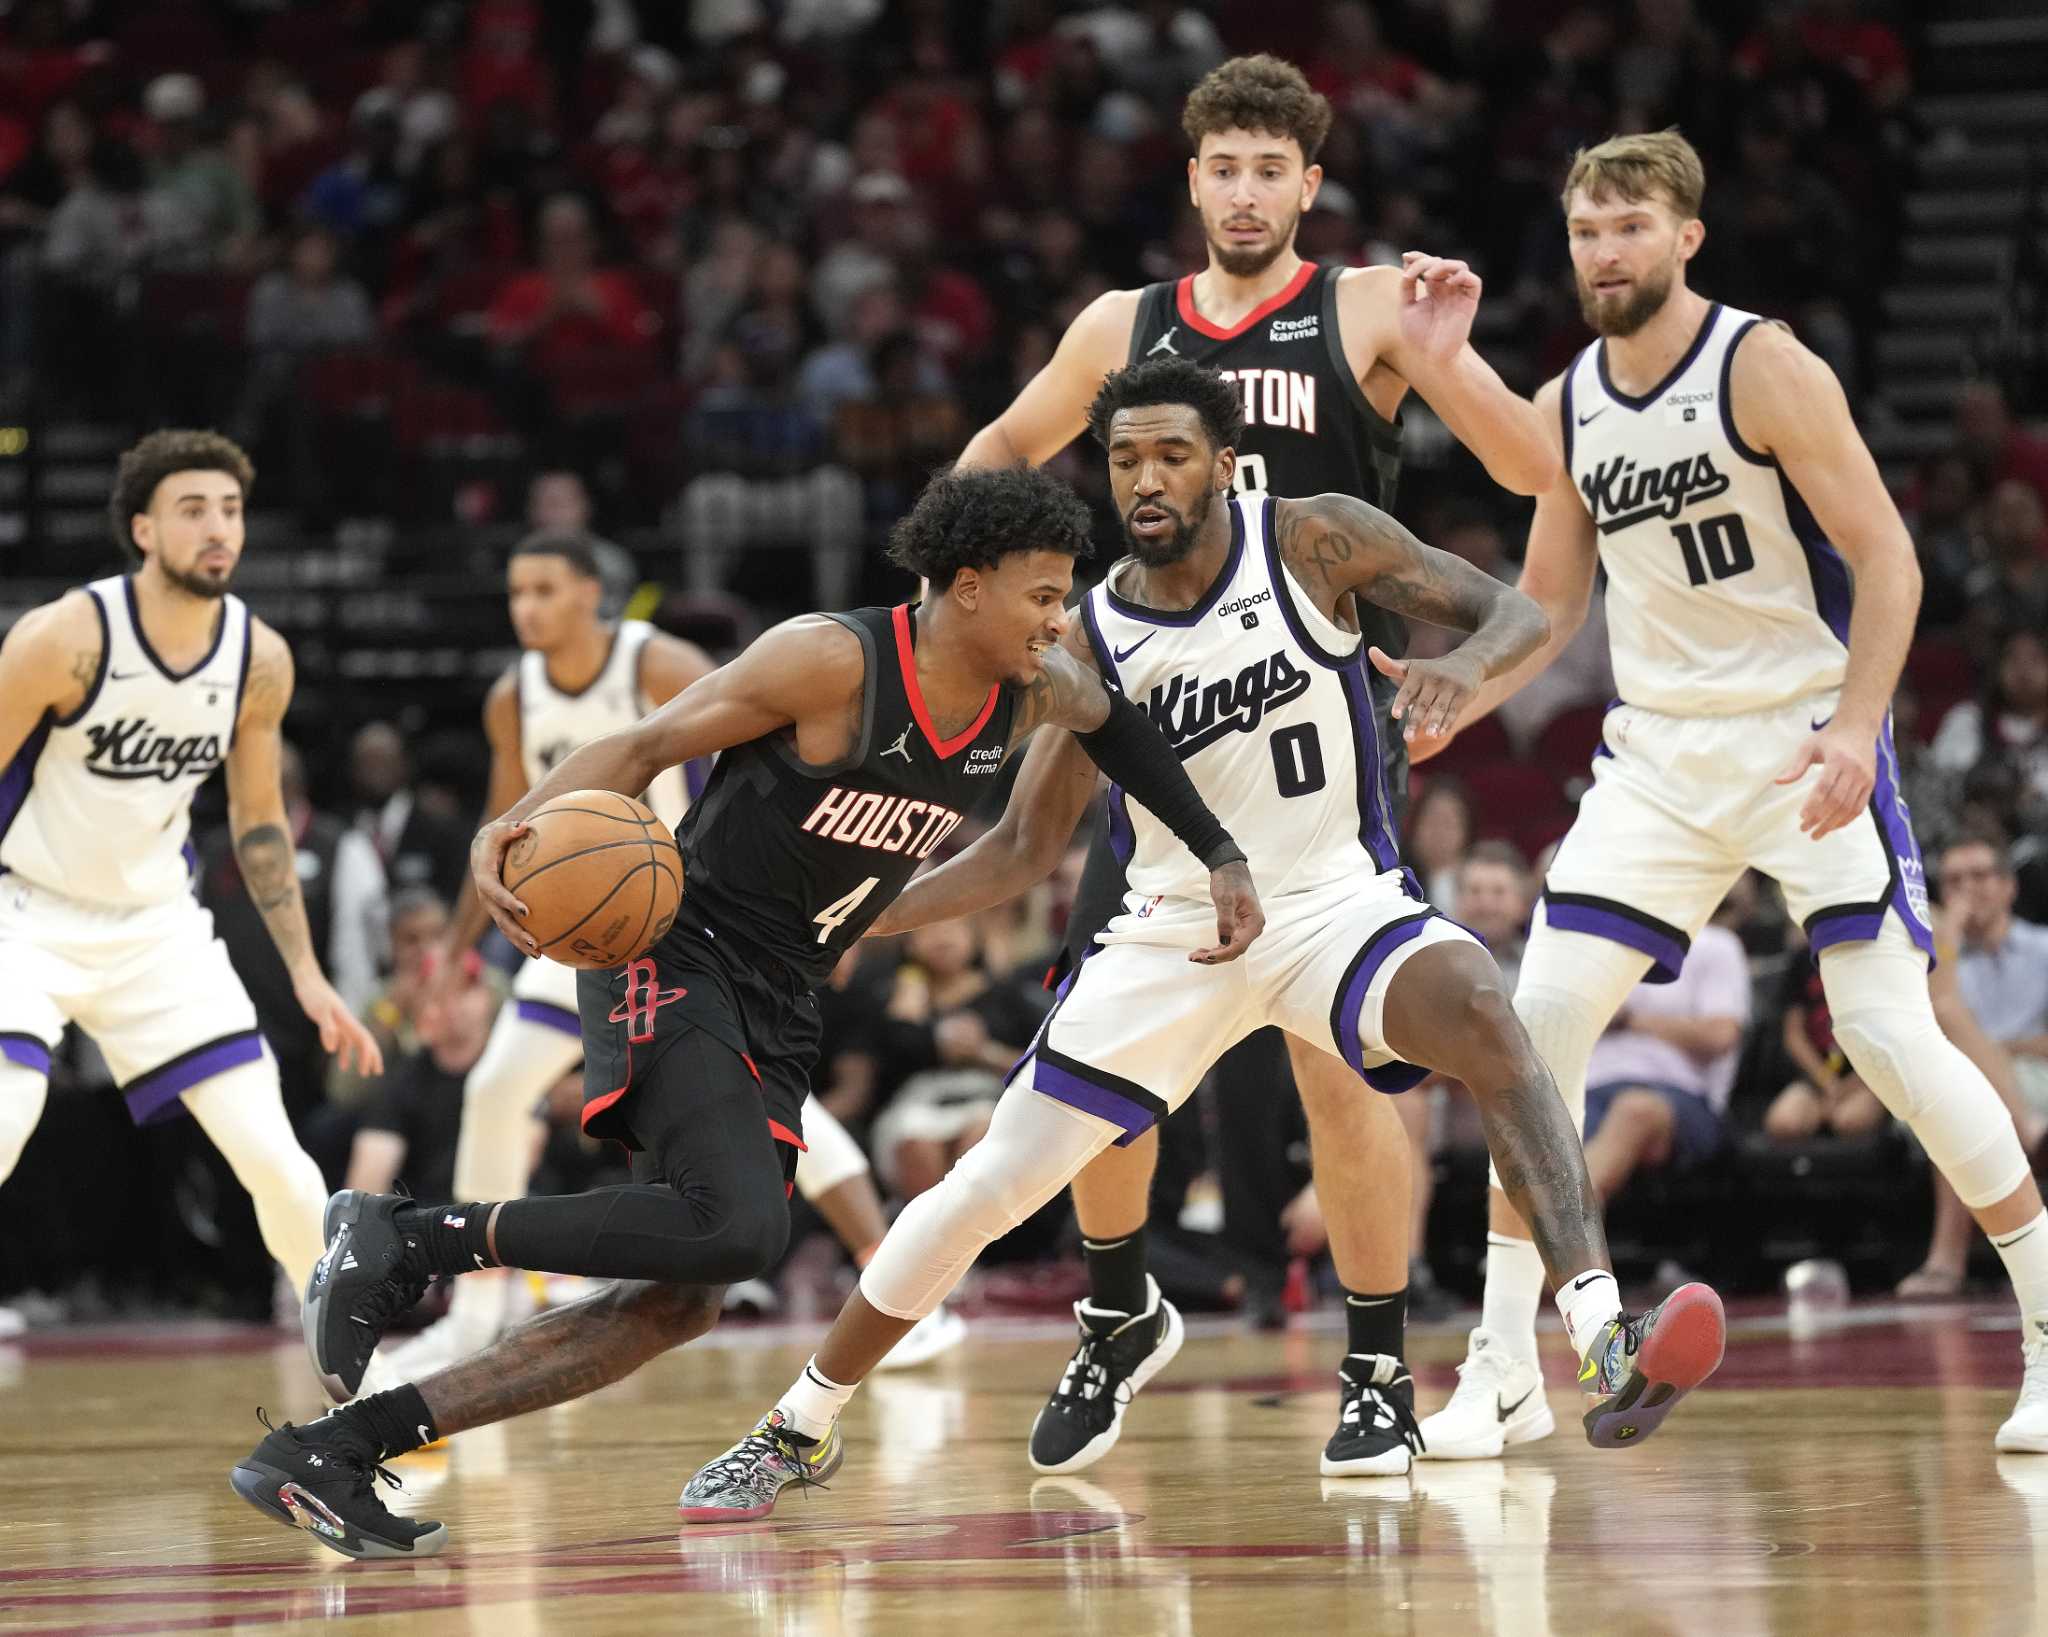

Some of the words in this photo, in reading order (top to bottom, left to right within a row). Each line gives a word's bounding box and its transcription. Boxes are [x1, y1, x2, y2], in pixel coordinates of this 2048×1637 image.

[1269, 326, 1319, 342] karma
[1272, 314, 1319, 331] credit
[1219, 368, 1317, 434] TON
[1582, 452, 1730, 537] Kings
[1669, 512, 1755, 587] 10
[1217, 587, 1272, 617] dialpad
[1137, 649, 1312, 763] Kings
[85, 717, 224, 783] Kings
[962, 760, 998, 775] karma
[970, 745, 1003, 761] credit
[1269, 721, 1327, 799] 0
[800, 786, 964, 860] HOUSTO
[811, 876, 881, 945] 4
